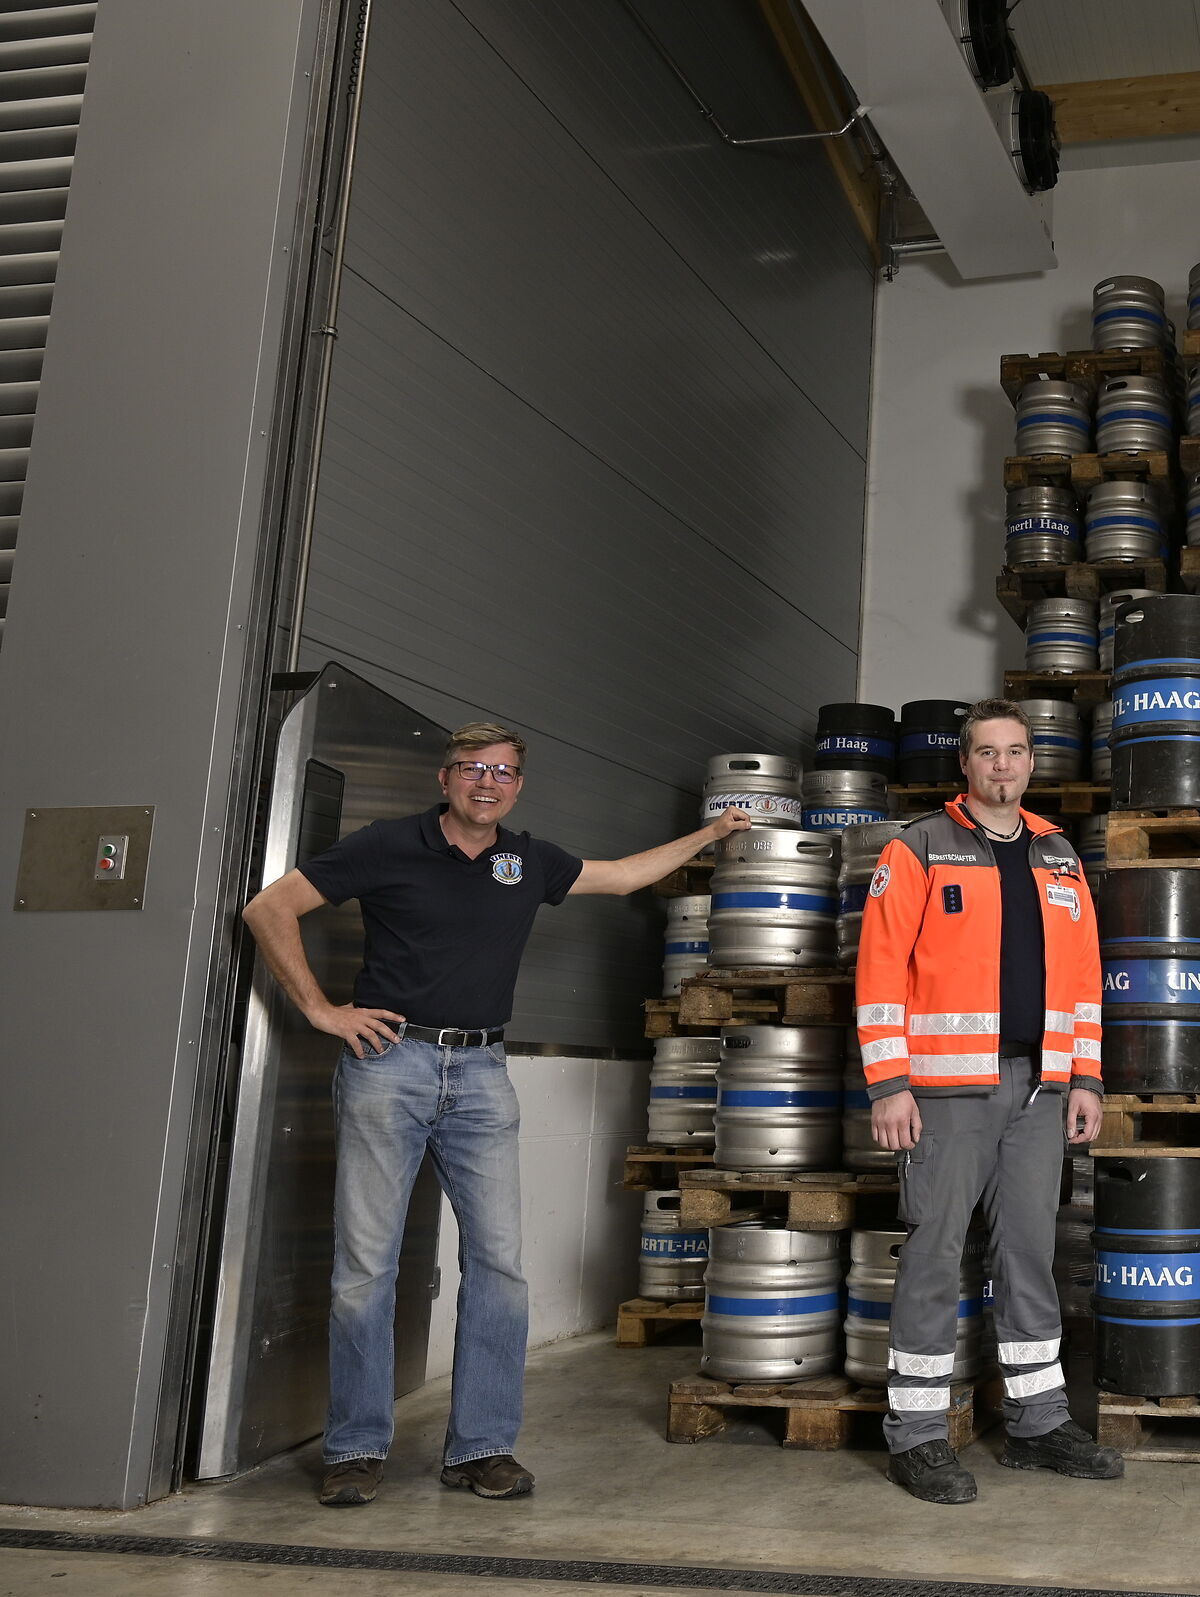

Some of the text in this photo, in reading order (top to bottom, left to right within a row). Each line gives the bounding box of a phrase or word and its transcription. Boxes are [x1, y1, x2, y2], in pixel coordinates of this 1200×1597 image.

[1040, 518, 1070, 536] Haag
[836, 737, 869, 753] Haag
[1102, 972, 1130, 990] AG
[641, 1237, 708, 1253] ERTL-HA
